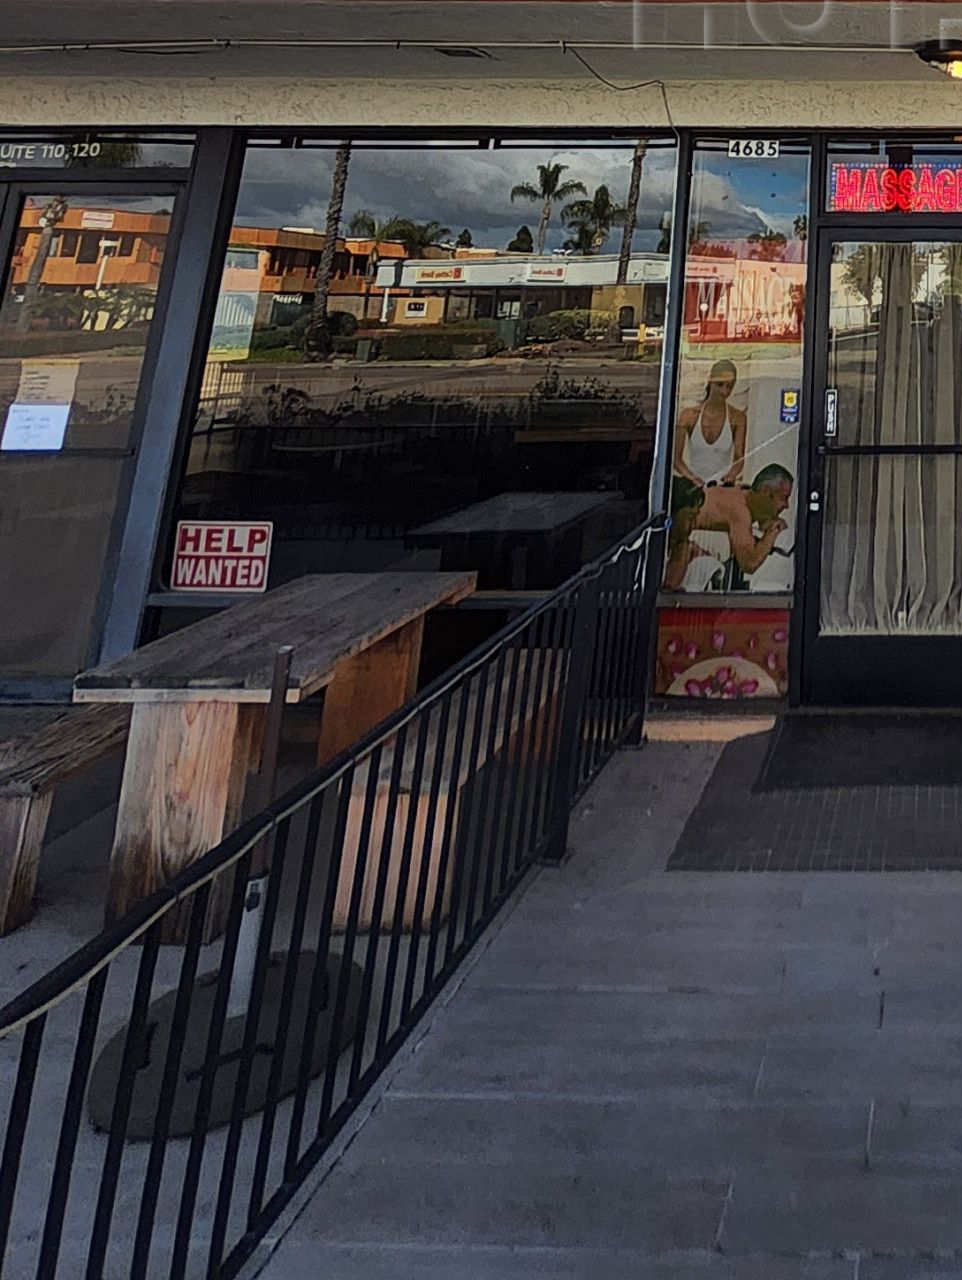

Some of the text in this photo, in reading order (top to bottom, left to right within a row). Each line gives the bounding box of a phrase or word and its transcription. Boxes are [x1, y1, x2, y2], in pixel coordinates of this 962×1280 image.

[730, 141, 779, 157] 4685
[826, 393, 836, 433] PUSH
[179, 527, 267, 553] HELP
[176, 558, 265, 586] WANTED
